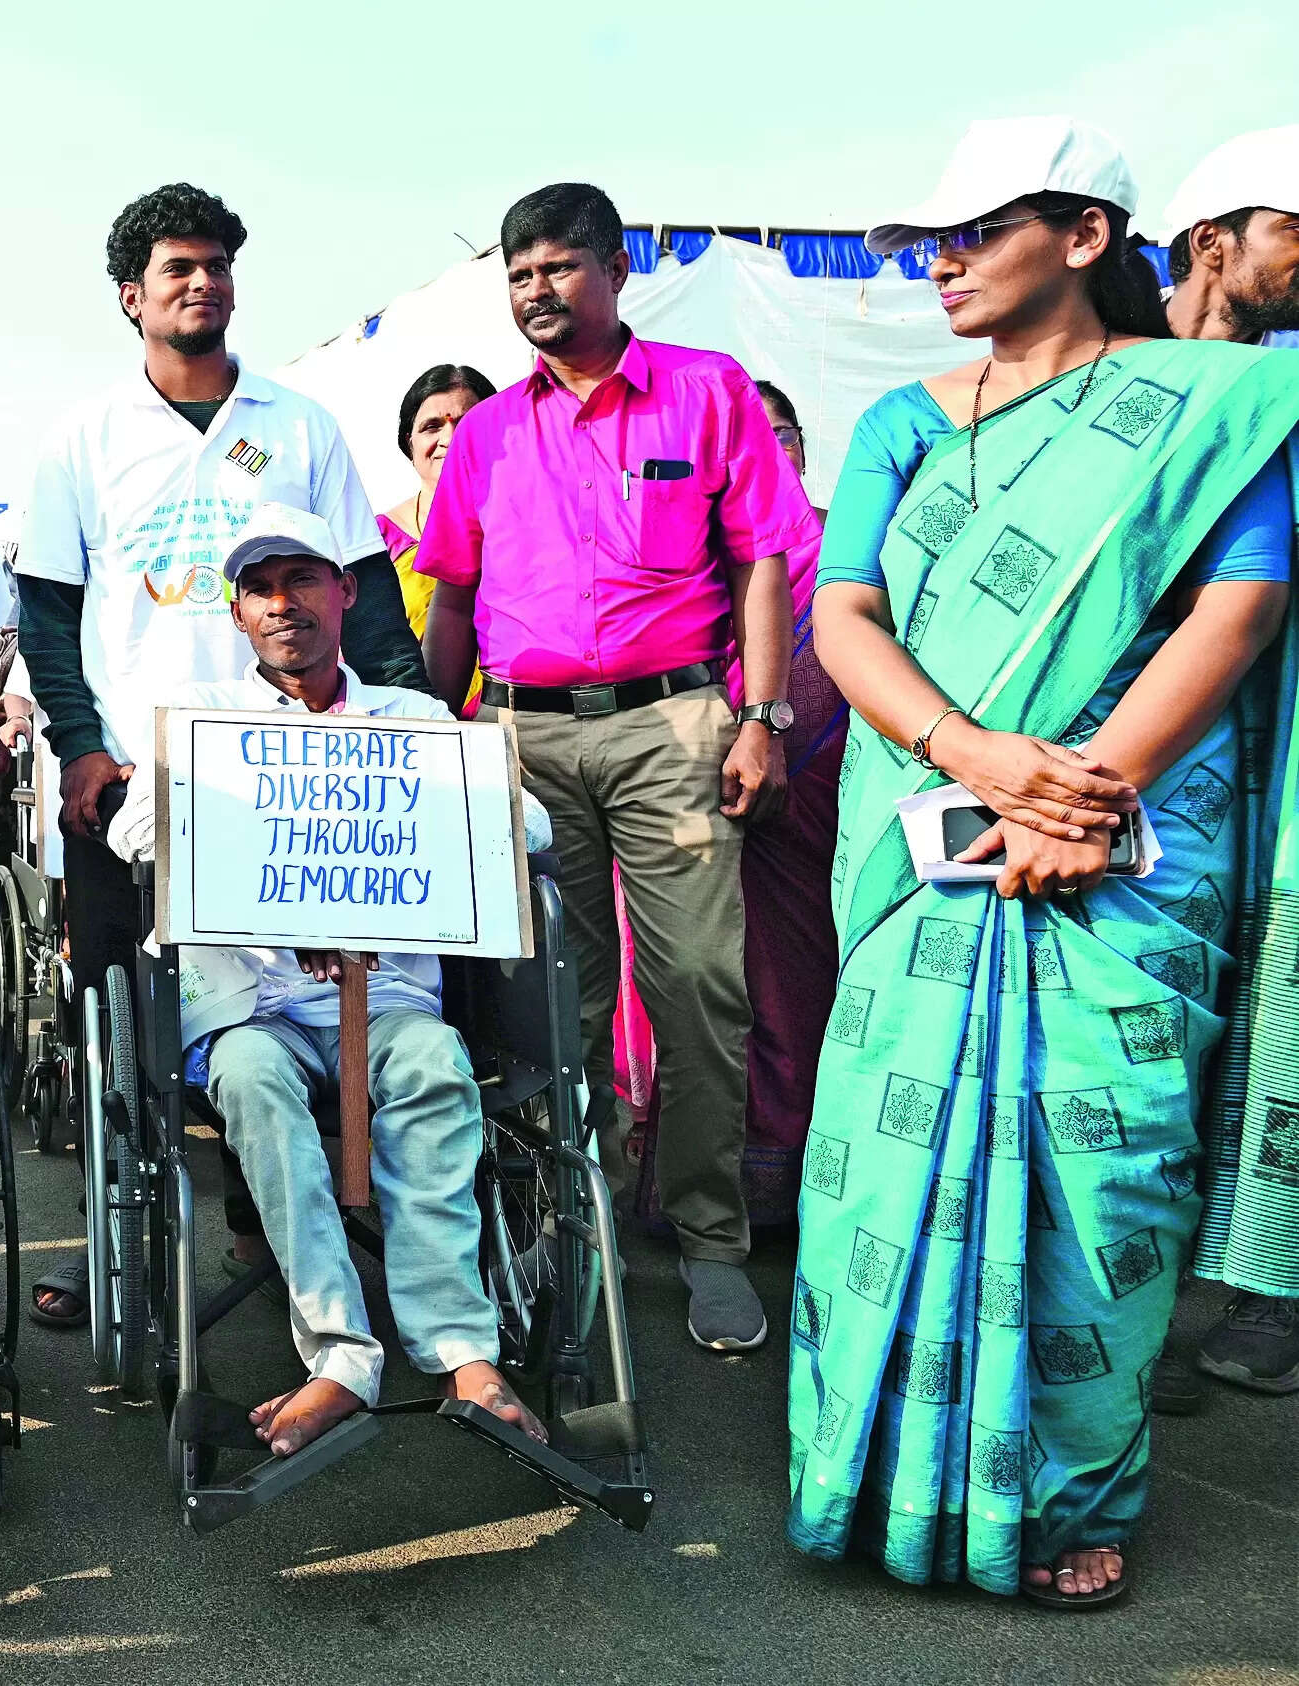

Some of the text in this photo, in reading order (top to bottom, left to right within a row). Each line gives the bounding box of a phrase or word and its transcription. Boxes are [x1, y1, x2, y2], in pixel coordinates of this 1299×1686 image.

[240, 729, 419, 770] CELEBRATE
[255, 772, 421, 813] DIVERSITY
[263, 817, 417, 857] THROUGH
[257, 863, 432, 905] DEMOCRACY
